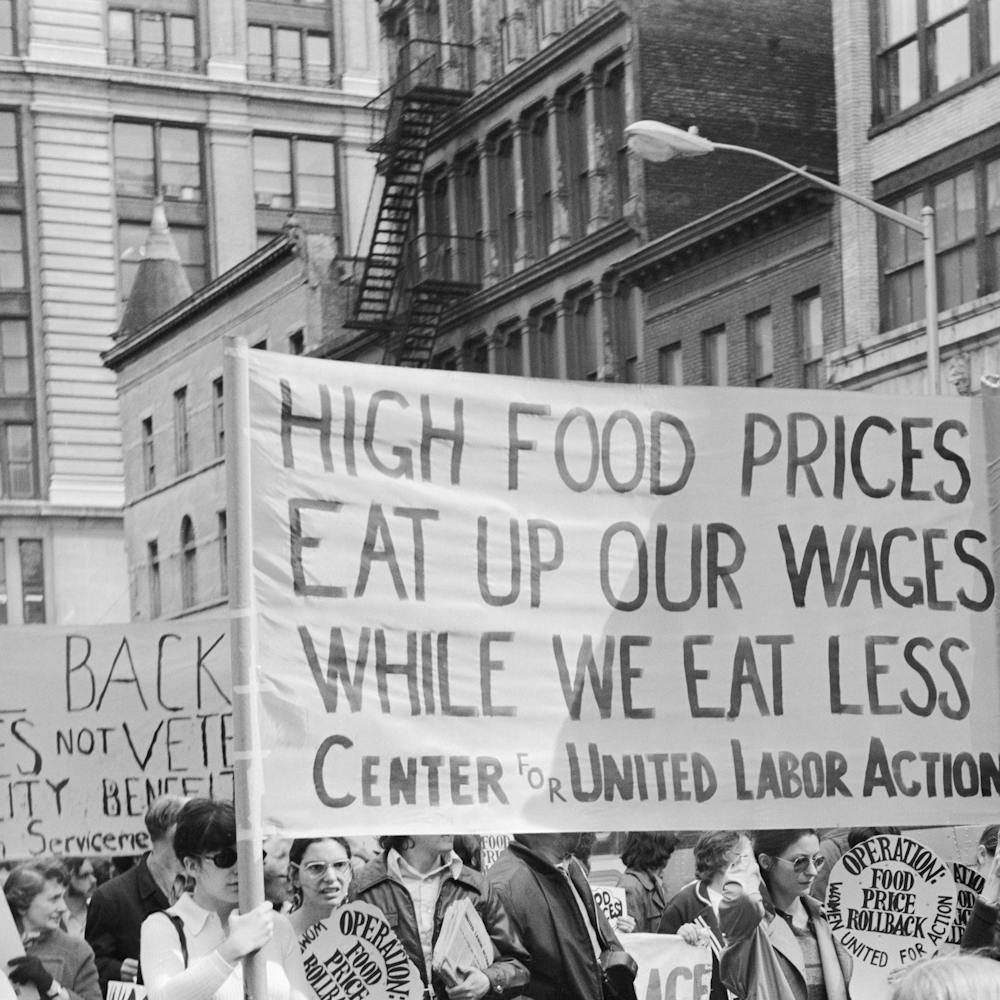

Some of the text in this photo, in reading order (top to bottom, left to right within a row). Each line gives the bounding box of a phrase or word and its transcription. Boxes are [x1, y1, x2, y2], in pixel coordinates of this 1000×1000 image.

[280, 379, 971, 504] HIGH FOOD PRICES
[288, 498, 996, 613] EAT UP OUR WAGES
[65, 632, 232, 712] BACK
[298, 626, 971, 720] WHILE WE EAT LESS
[56, 728, 115, 755] NOT
[123, 713, 234, 772] VETE
[313, 734, 510, 809] CENTER
[517, 752, 567, 803] FOR
[565, 742, 718, 802] UNITED
[731, 738, 853, 801] LABOR
[27, 818, 151, 856] Serviceme
[842, 836, 946, 886] OPERATION:
[861, 888, 917, 914] PRICE
[871, 868, 915, 892] FOOD
[339, 910, 411, 1000] OPERATION:
[827, 881, 844, 932] WOMEN
[840, 932, 889, 968] UNITED
[899, 942, 928, 964] FOR
[927, 895, 953, 946] ACTION
[846, 908, 928, 939] ROLLBACK
[345, 939, 382, 986] FOOD
